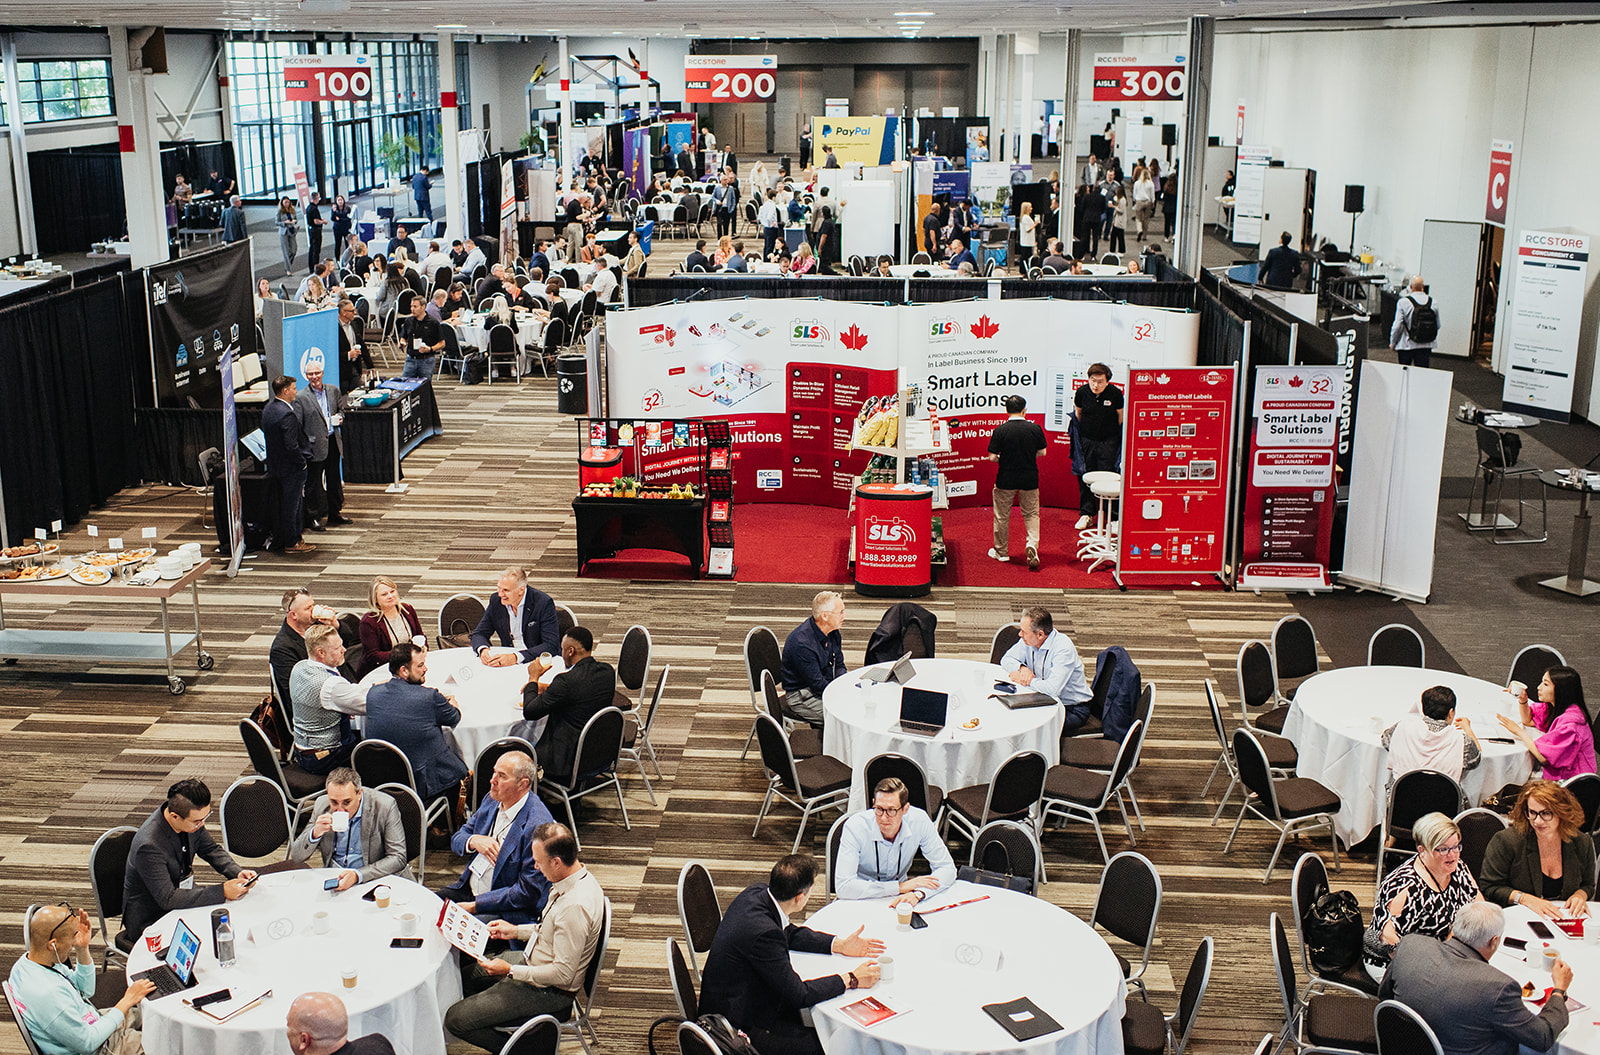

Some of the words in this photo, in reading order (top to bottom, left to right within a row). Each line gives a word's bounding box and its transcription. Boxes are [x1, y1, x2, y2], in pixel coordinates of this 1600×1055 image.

[286, 80, 305, 88] AISLE
[314, 71, 371, 97] 100
[687, 81, 707, 89] AISLE
[711, 72, 776, 98] 200
[1120, 70, 1185, 97] 300
[835, 127, 871, 137] PayPal
[1491, 172, 1505, 210] C
[793, 325, 820, 339] SLS
[930, 321, 952, 336] SLS
[1134, 323, 1152, 341] 32
[934, 360, 953, 368] Label
[954, 358, 985, 366] Business
[986, 356, 1008, 364] Since
[1010, 356, 1028, 364] 1991
[927, 371, 979, 391] Smart
[984, 370, 1038, 387] Label
[1136, 374, 1149, 382] SLS
[1266, 377, 1280, 385] SLS
[1309, 378, 1330, 394] 32
[643, 392, 660, 412] 32
[926, 392, 1009, 411] Solutions
[1263, 413, 1298, 424] Smart
[1300, 413, 1332, 423] Label
[964, 430, 977, 438] We
[1269, 424, 1324, 435] Solutions
[730, 430, 782, 444] olutions
[641, 437, 676, 457] Smart
[645, 473, 655, 482] You
[655, 470, 671, 479] Need
[868, 524, 903, 541] SLS
[859, 552, 918, 563] 1.888.389.8989
